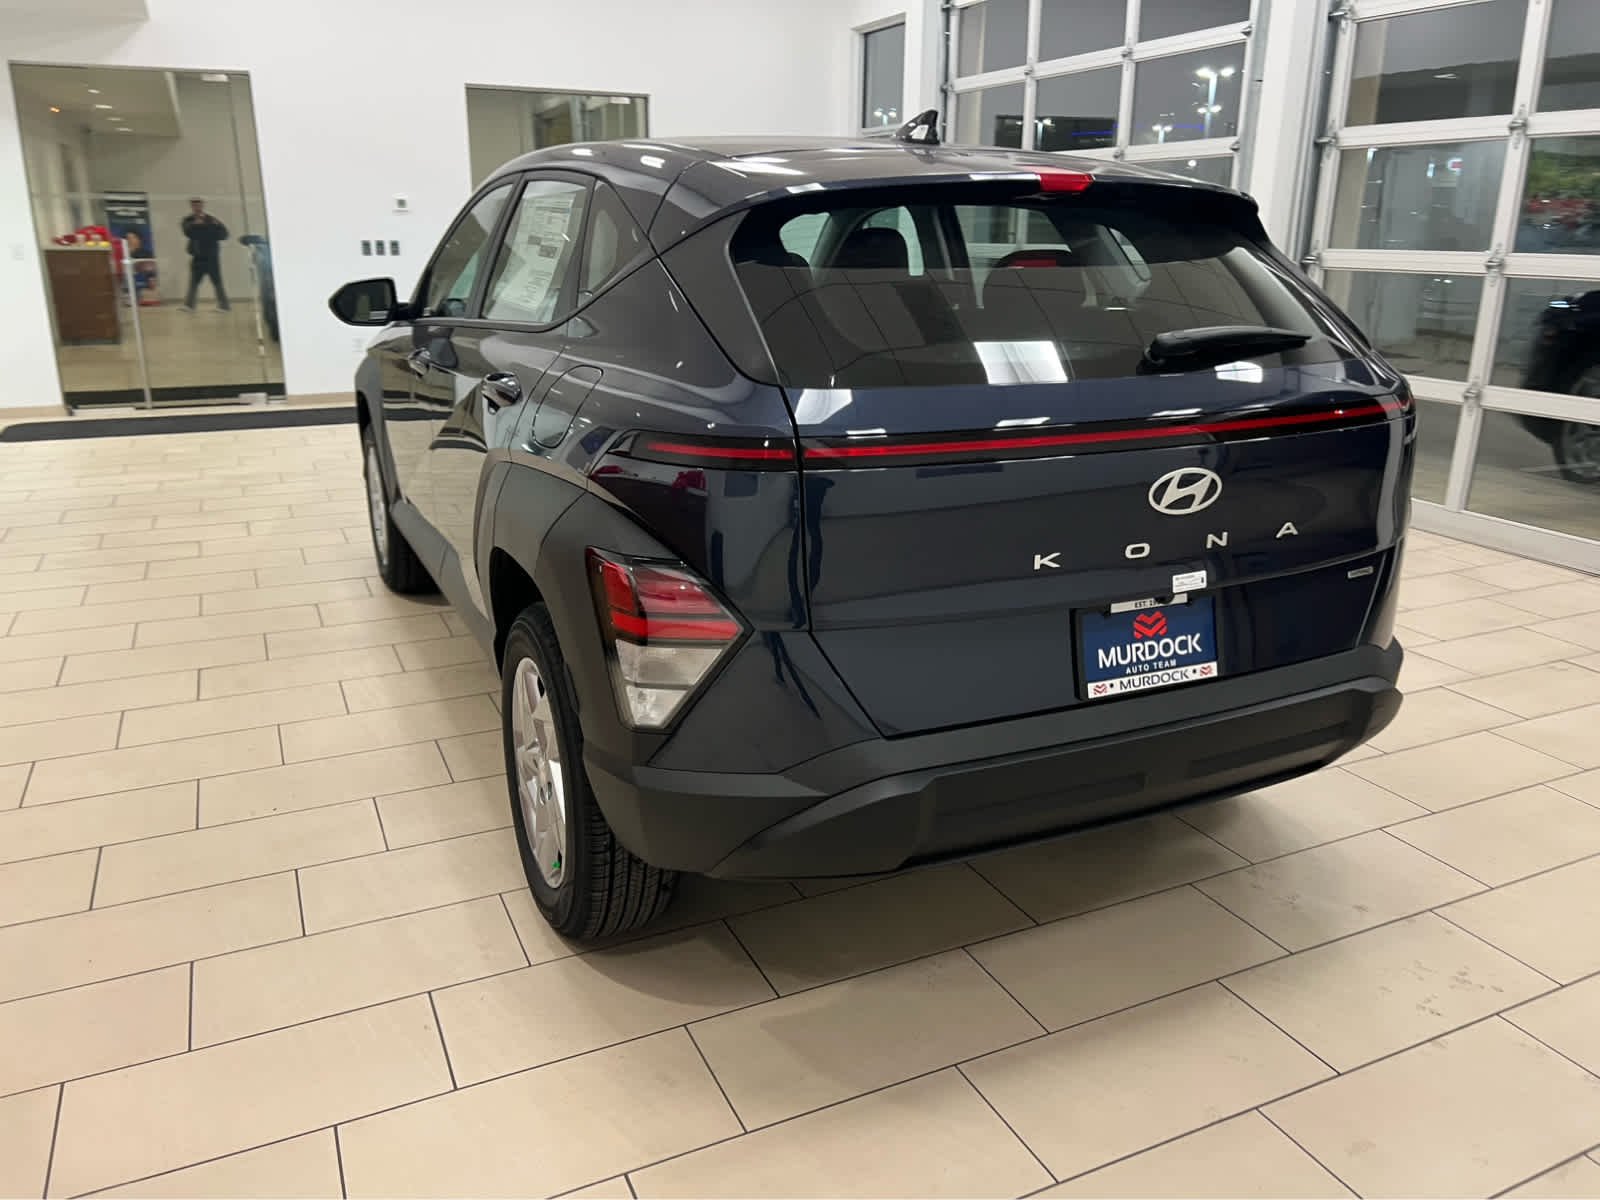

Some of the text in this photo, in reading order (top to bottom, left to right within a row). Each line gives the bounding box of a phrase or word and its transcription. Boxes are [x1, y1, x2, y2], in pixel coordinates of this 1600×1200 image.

[1033, 522, 1298, 570] KONA
[1097, 633, 1202, 669] MURDOCK
[1119, 669, 1189, 690] MURDOCK
[1125, 658, 1177, 675] AUTO TEAM
